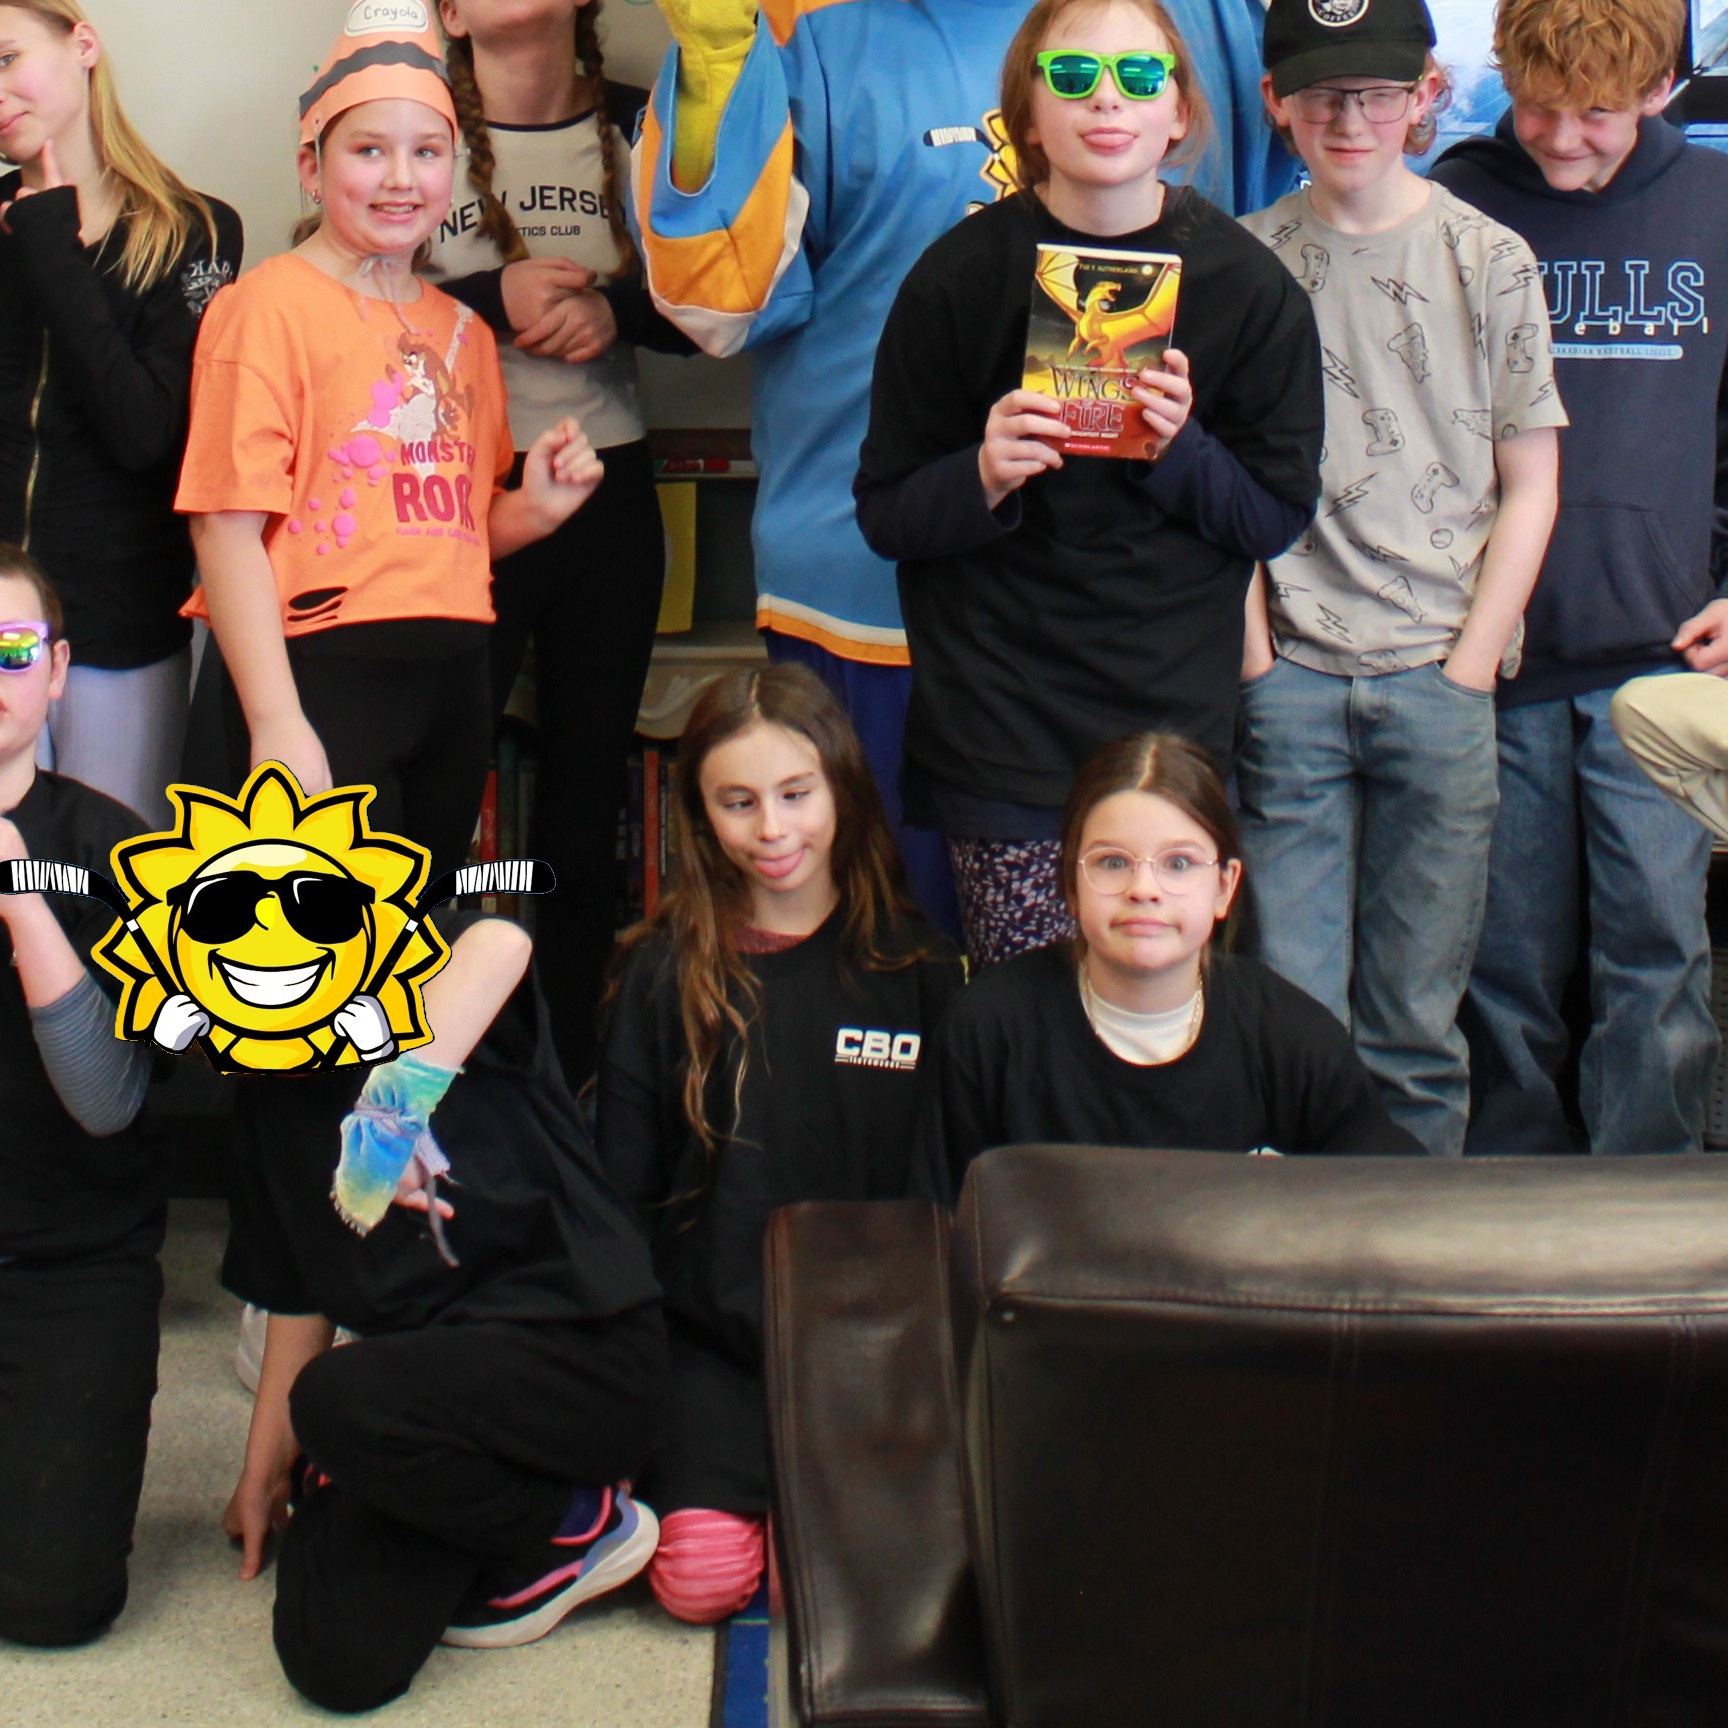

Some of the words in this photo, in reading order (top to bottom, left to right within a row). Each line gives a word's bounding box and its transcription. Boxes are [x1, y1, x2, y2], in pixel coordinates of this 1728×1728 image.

[362, 3, 419, 23] Crayola
[550, 225, 581, 236] CLUB
[836, 1028, 921, 1061] CBO
